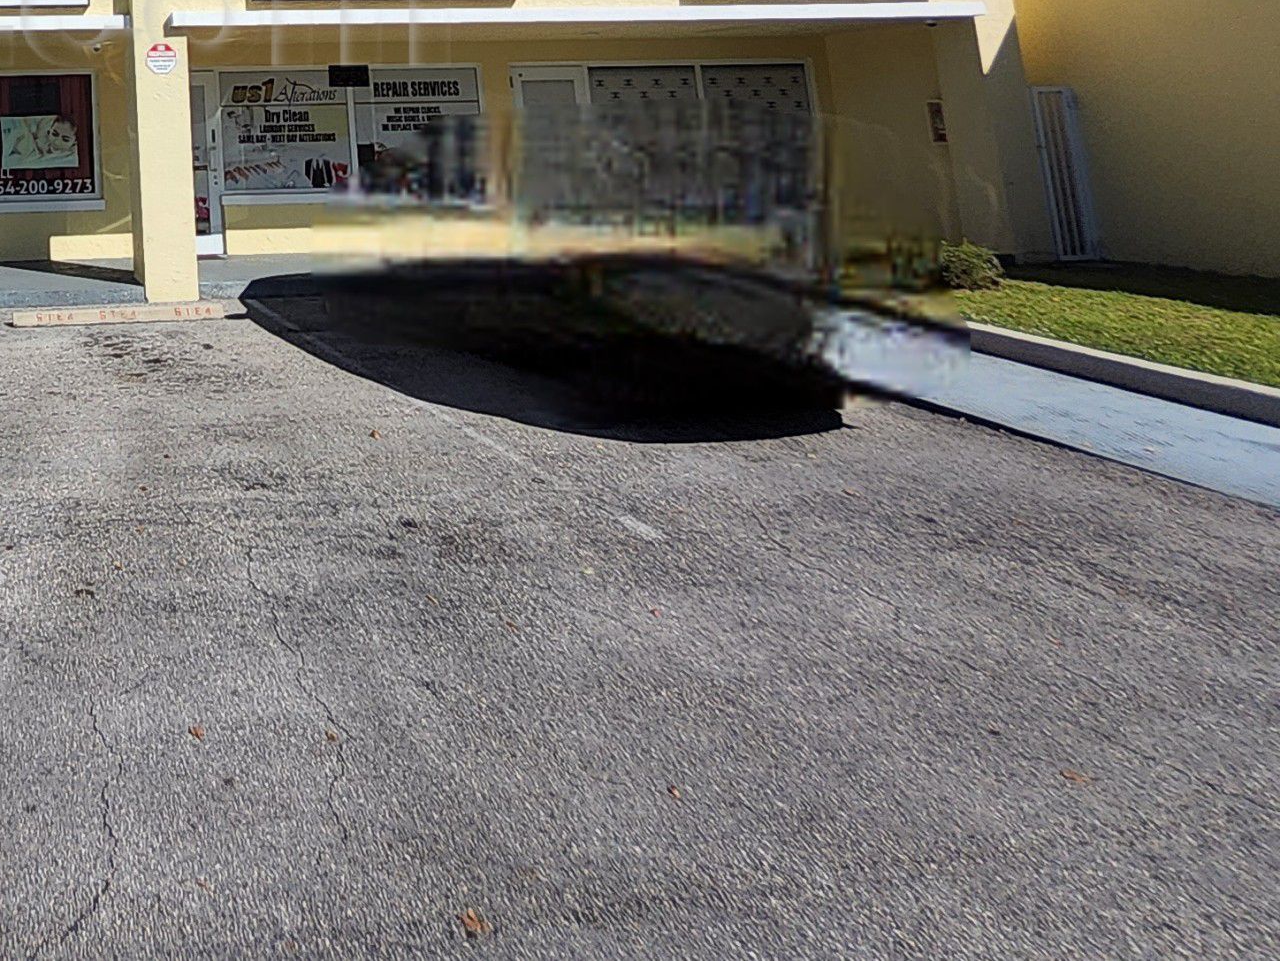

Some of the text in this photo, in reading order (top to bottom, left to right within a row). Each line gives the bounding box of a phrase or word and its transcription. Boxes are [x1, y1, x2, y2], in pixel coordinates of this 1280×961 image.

[274, 77, 338, 106] Alterations
[373, 80, 460, 98] REPAIR SERVICES
[264, 109, 310, 124] Dry Clean
